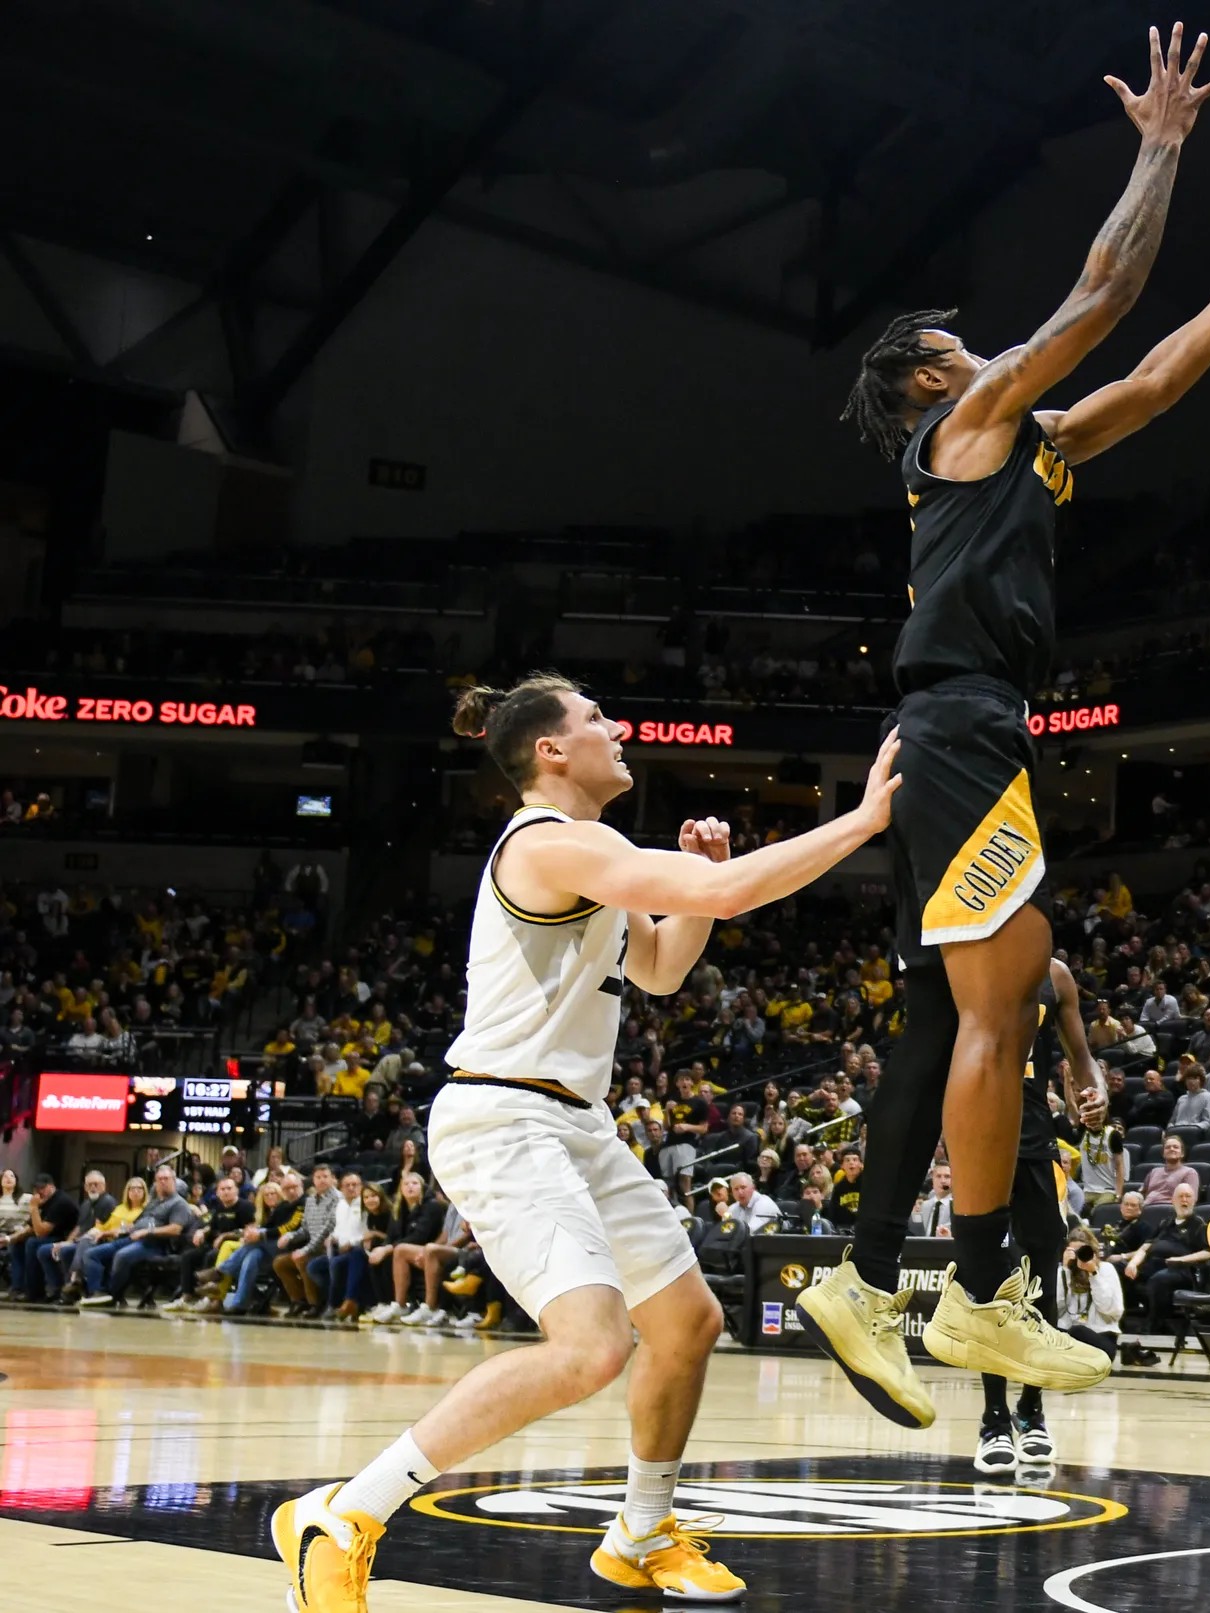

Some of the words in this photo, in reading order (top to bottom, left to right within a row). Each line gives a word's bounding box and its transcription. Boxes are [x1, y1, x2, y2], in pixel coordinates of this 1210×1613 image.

[77, 699, 153, 722] ZERO
[160, 702, 256, 726] SUGAR
[1049, 704, 1119, 733] SUGAR
[639, 721, 733, 744] SUGAR
[954, 821, 1034, 912] GOLDEN
[144, 1100, 162, 1121] 3
[897, 1268, 946, 1291] RTNER
